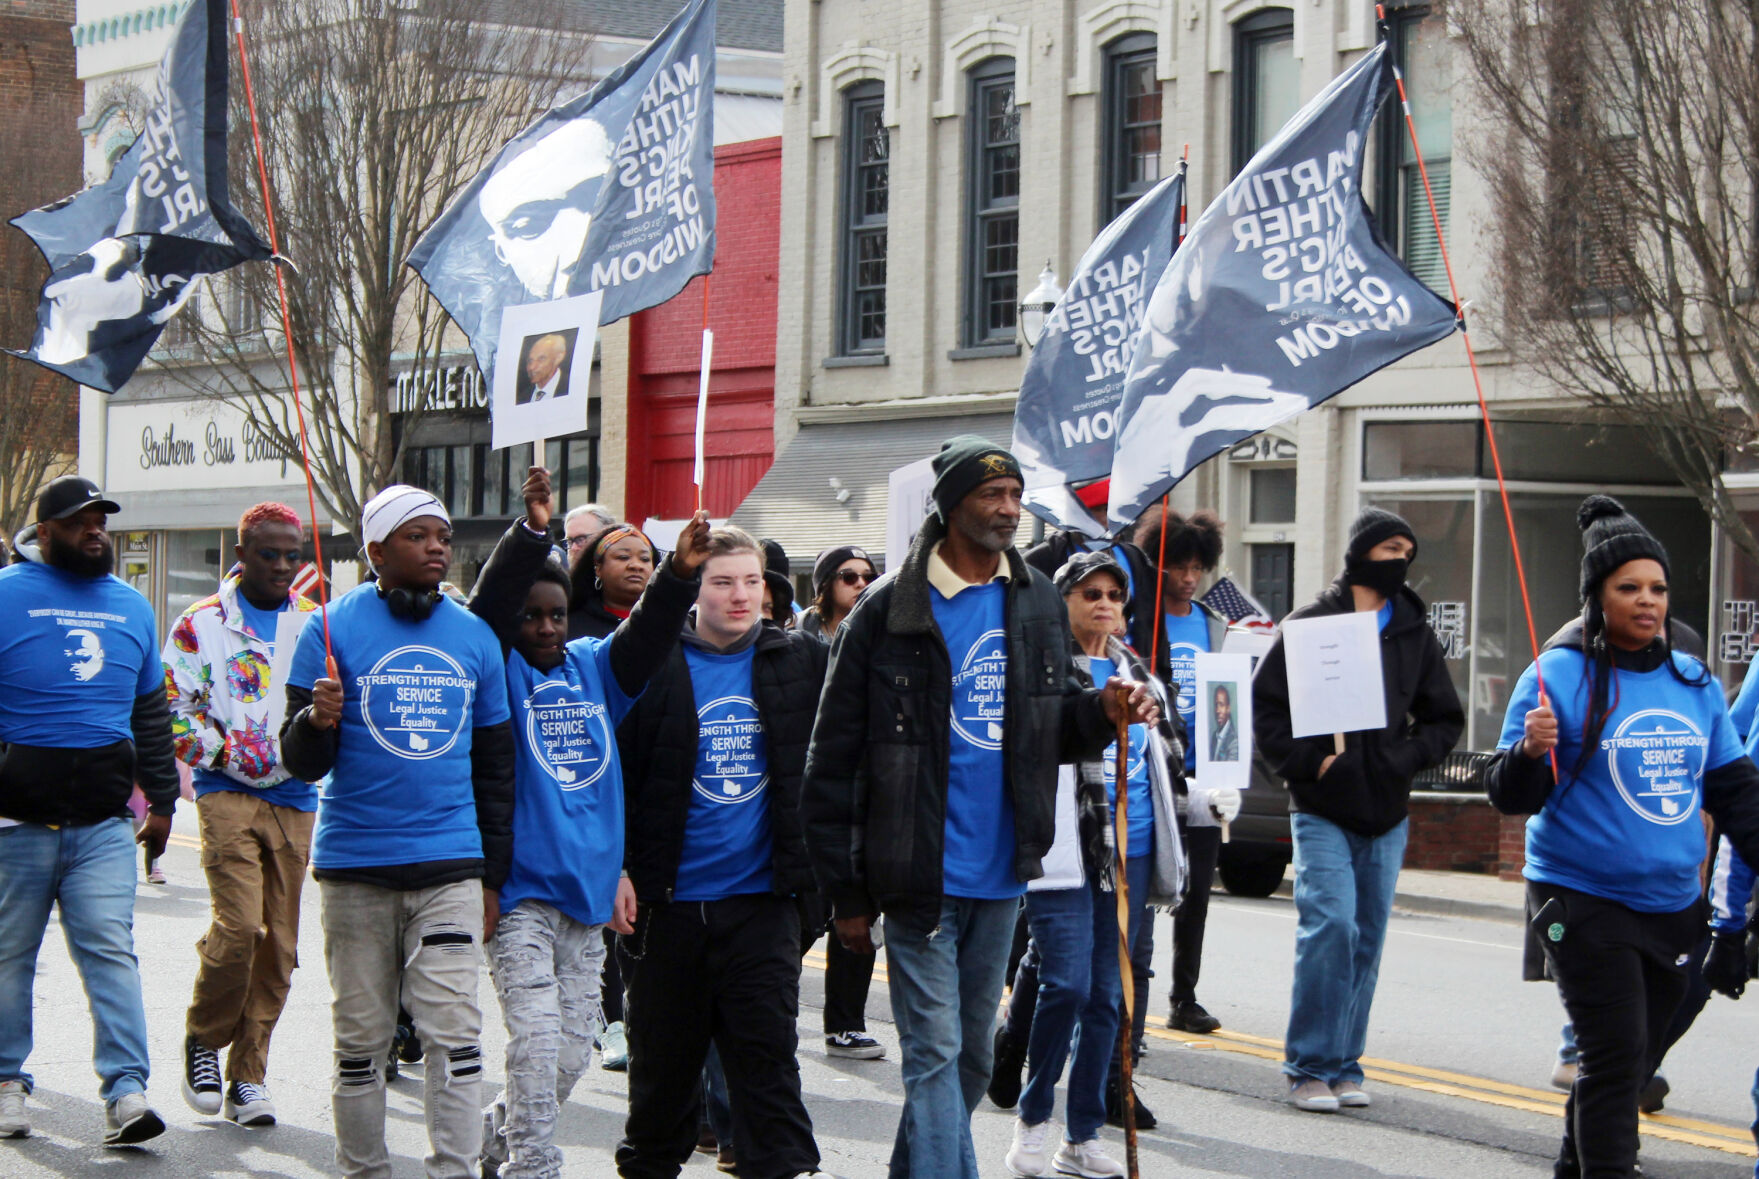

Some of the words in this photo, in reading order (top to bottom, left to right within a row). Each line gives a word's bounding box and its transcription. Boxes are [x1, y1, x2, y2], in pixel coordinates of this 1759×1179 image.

[140, 422, 196, 470] Southern
[204, 421, 236, 467] Sass
[242, 418, 301, 479] Boutiqe
[356, 675, 420, 687] STRENGTH
[420, 676, 477, 690] THROUGH
[396, 687, 442, 703] SERVICE
[967, 690, 994, 705] Legal
[389, 702, 416, 716] Legal
[417, 703, 448, 716] Justice
[977, 704, 1004, 719] Equal
[400, 715, 438, 729] Equality
[541, 720, 585, 736] SERVICE
[698, 725, 732, 738] ENGTH
[561, 736, 592, 748] Justice
[711, 735, 752, 751] SERVICE
[1601, 737, 1663, 750] STRENGTH
[546, 748, 584, 762] Equality
[705, 750, 730, 763] Legal
[730, 750, 757, 761] Justice
[1641, 749, 1686, 766] SERVICE
[715, 762, 749, 776] Equality
[1637, 766, 1663, 778] Legal
[1663, 766, 1689, 778] Justice
[1650, 777, 1682, 793] Equality
